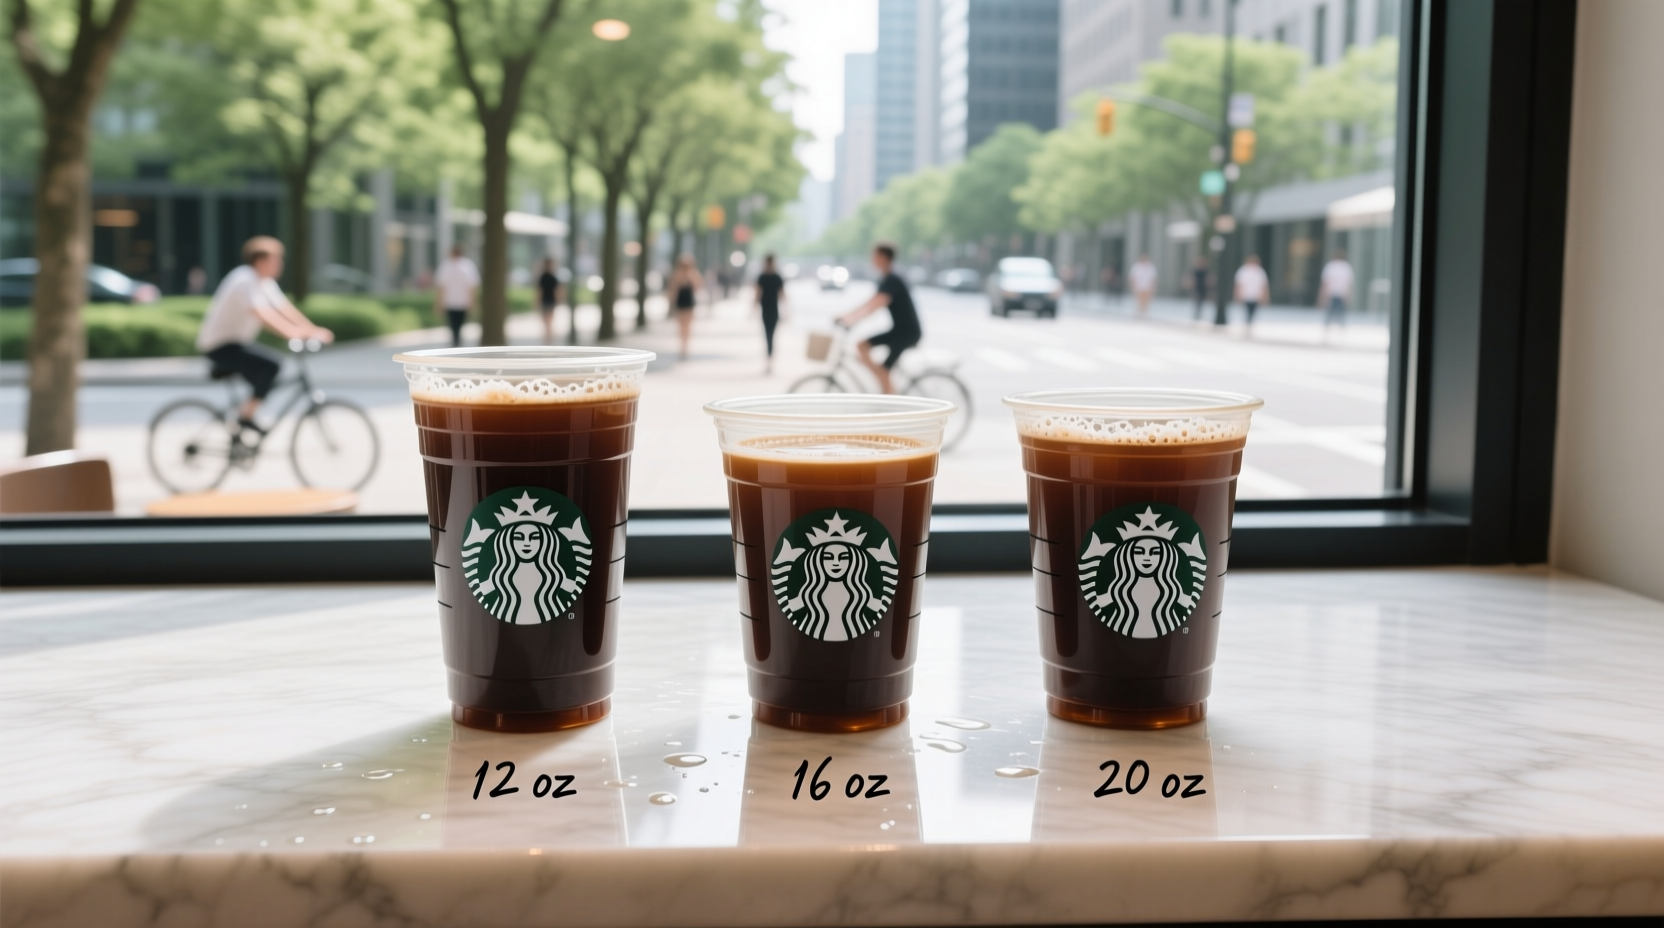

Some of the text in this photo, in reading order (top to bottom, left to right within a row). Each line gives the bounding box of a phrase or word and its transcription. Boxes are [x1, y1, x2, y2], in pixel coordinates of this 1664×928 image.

[472, 759, 577, 801] 12 oz
[792, 755, 891, 801] 16 oz
[1093, 759, 1207, 799] 20 oz
